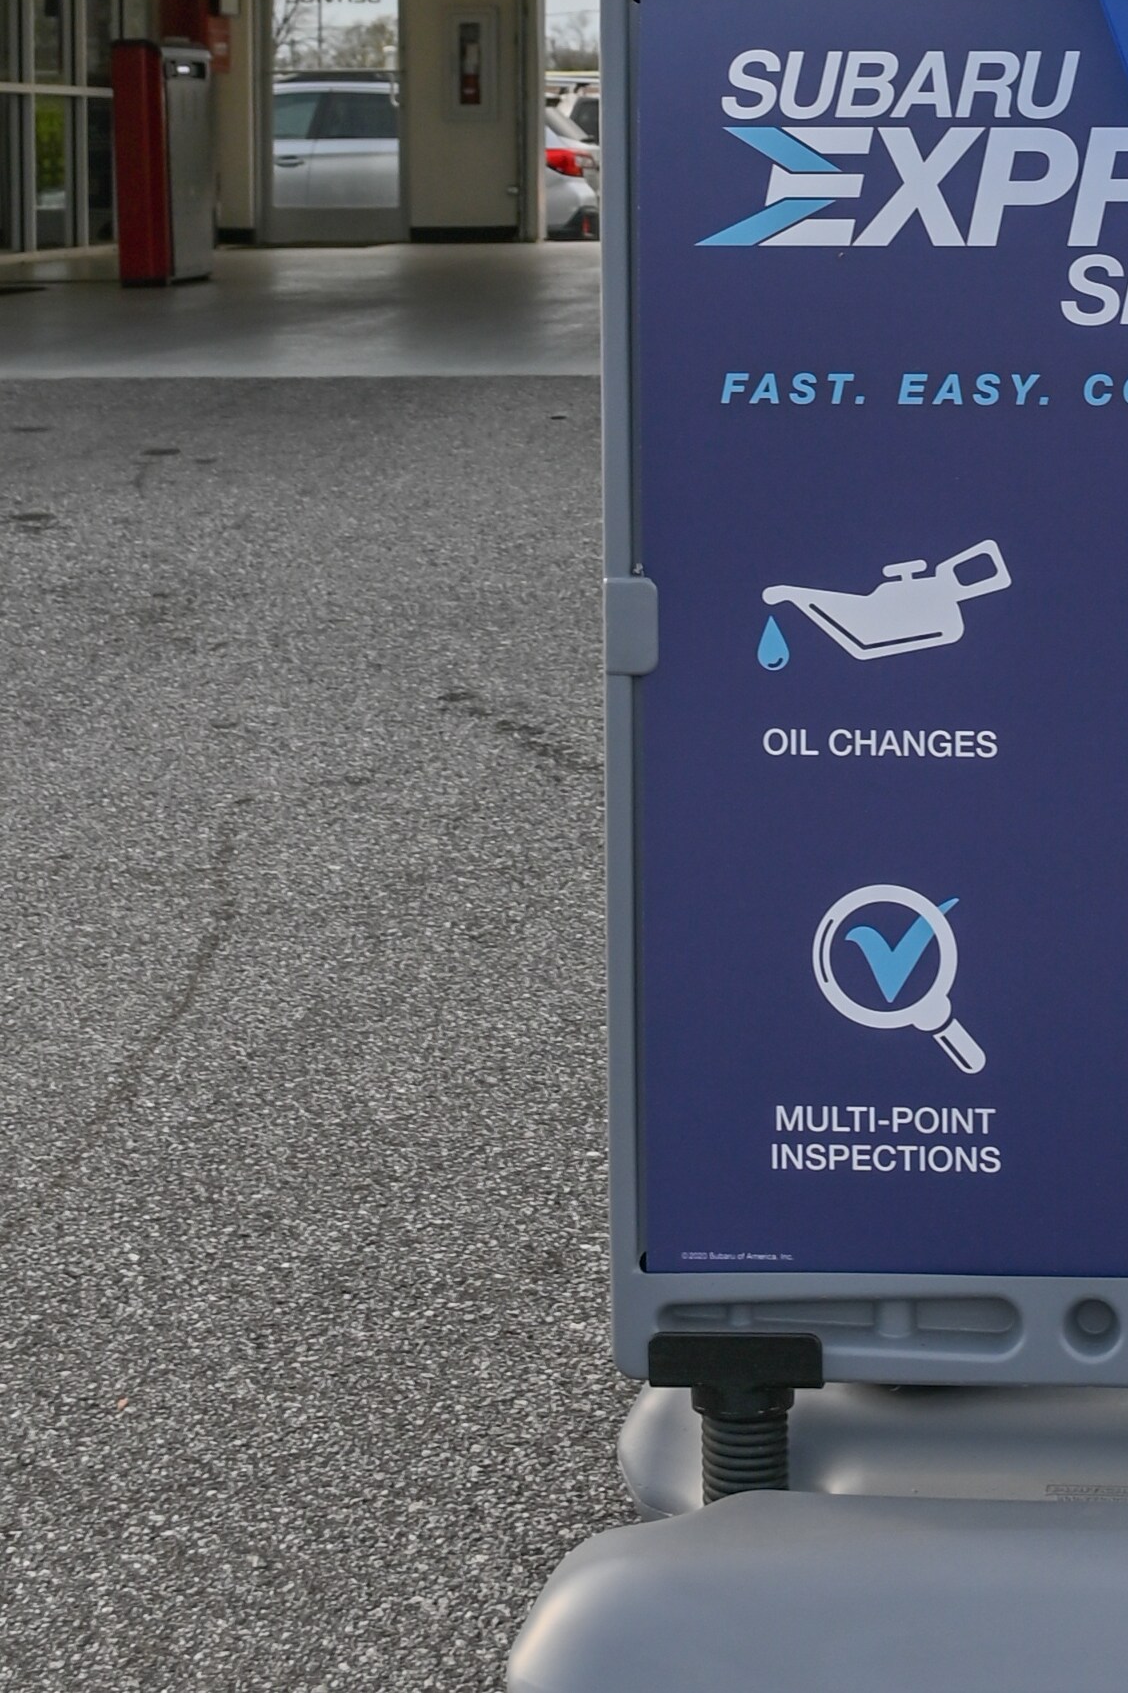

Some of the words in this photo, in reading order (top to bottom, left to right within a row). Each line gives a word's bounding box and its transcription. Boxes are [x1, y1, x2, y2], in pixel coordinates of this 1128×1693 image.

[721, 49, 1081, 120] SUBARU
[720, 372, 865, 405] FAST.
[897, 373, 1049, 406] EASY.
[762, 728, 820, 756] OIL
[828, 728, 998, 758] CHANGES
[775, 1105, 996, 1135] MULTI-POINT
[771, 1143, 1001, 1173] INSPECTIONS
